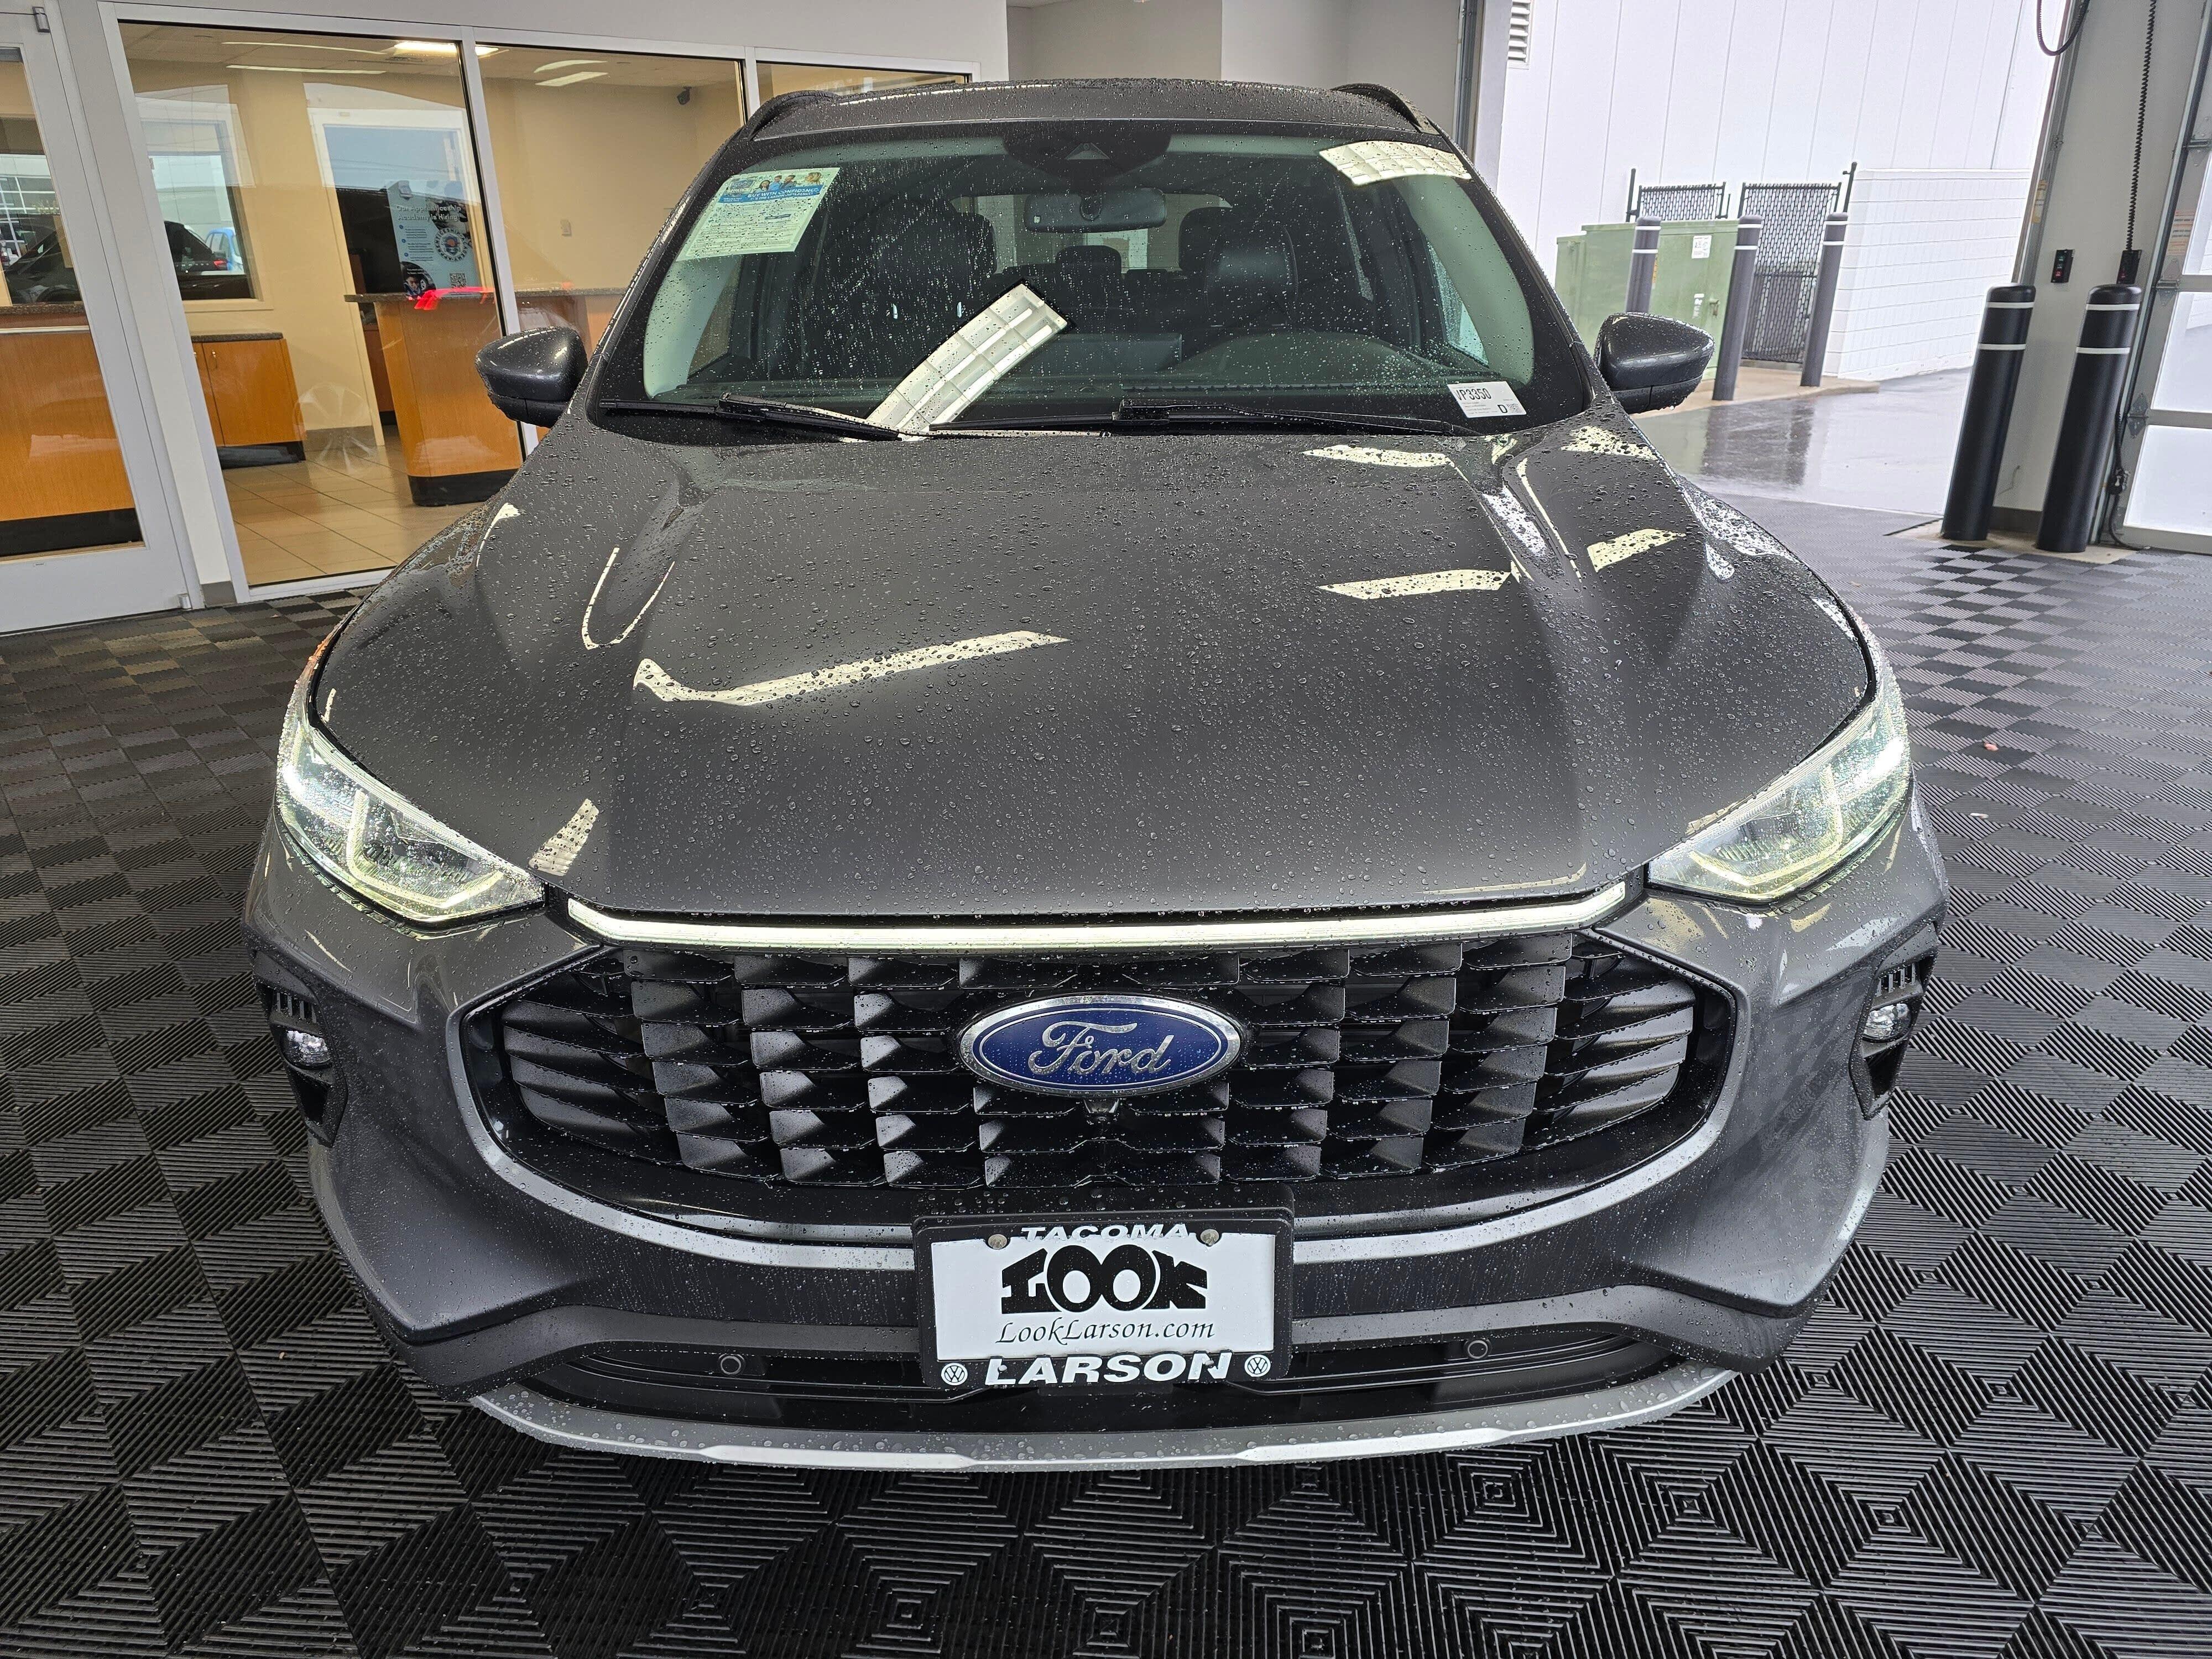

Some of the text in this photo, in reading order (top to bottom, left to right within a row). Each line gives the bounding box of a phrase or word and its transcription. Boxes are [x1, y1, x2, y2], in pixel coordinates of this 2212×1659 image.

[398, 213, 430, 221] Academy
[1454, 388, 1491, 400] VP3350
[1498, 404, 1508, 413] D
[1028, 1021, 1174, 1074] Ford
[1020, 1223, 1191, 1241] TACOMA
[1001, 1244, 1208, 1314] LOOK
[995, 1317, 1215, 1346] LookLarson.com
[984, 1352, 1234, 1386] LARSON
